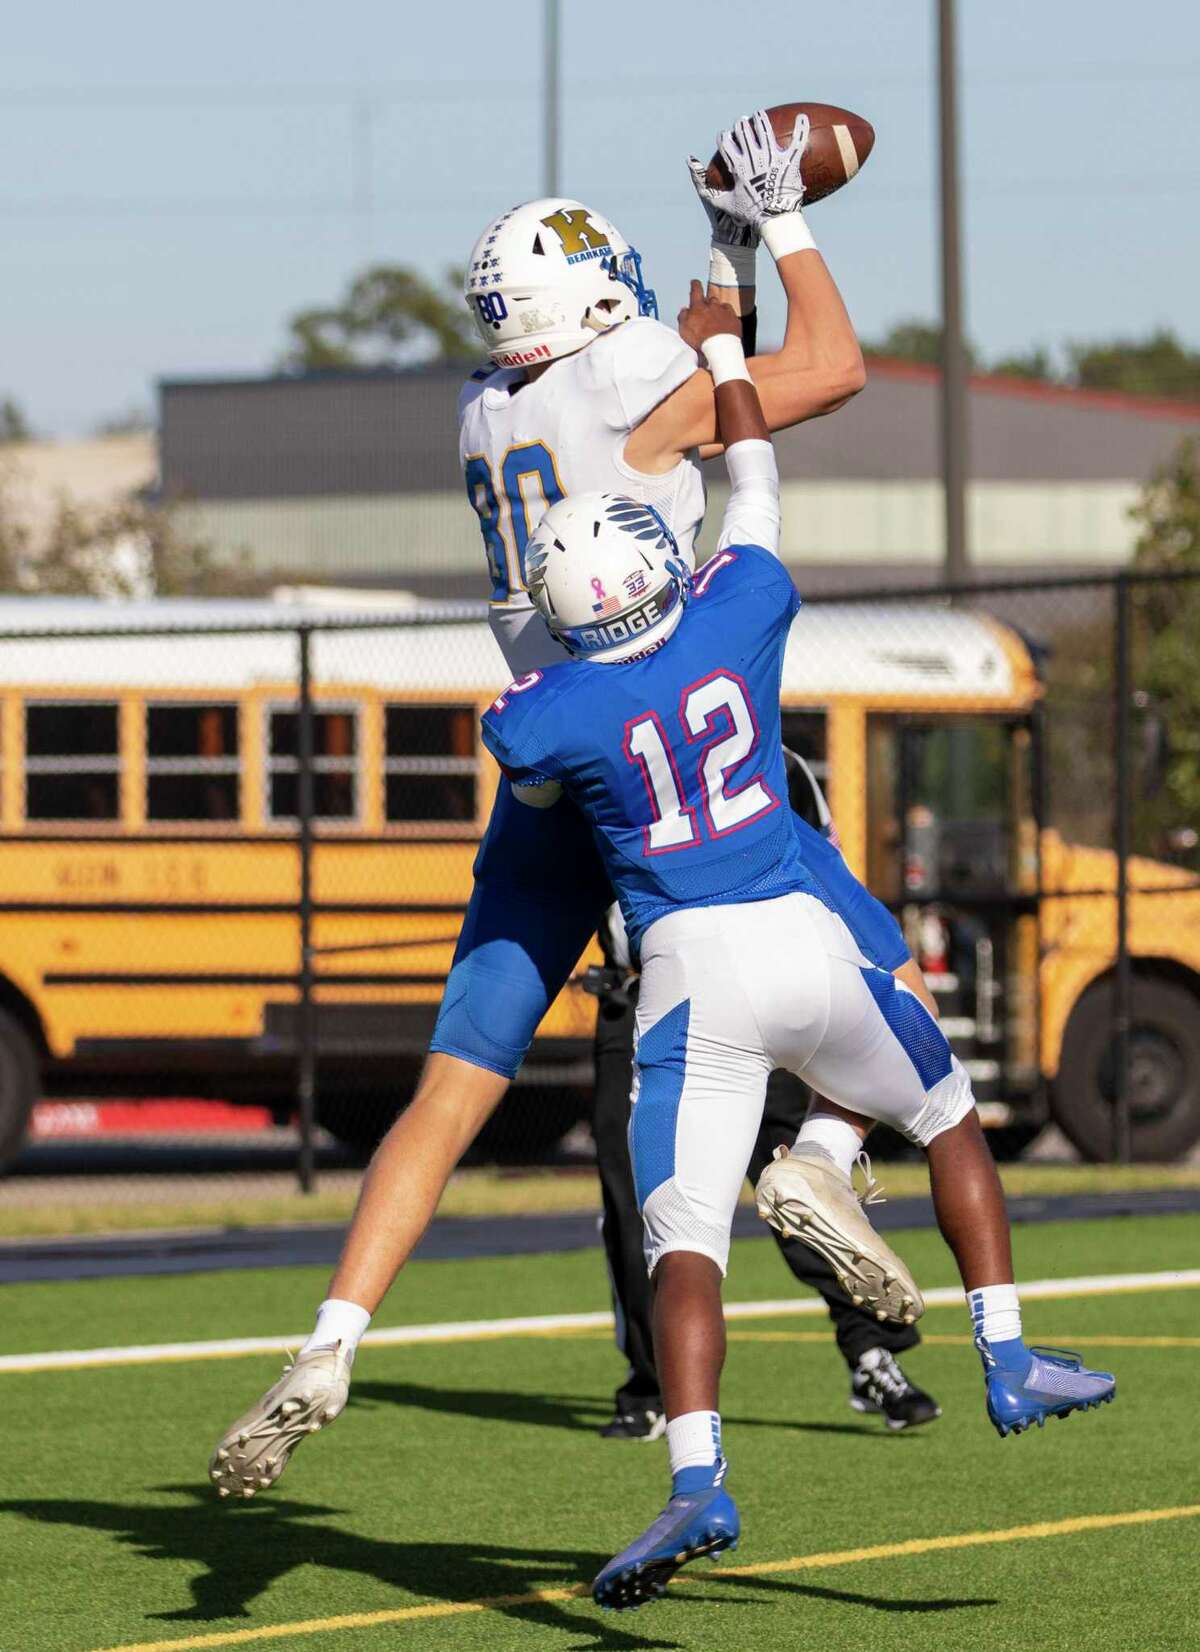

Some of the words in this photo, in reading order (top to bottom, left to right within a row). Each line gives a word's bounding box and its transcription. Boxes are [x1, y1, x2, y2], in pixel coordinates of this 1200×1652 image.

[766, 167, 779, 204] adidas
[540, 207, 610, 256] K
[475, 290, 509, 325] 80
[490, 343, 551, 367] iddell
[625, 573, 646, 595] 33
[580, 600, 663, 648] RIDGE
[622, 667, 782, 858] 12
